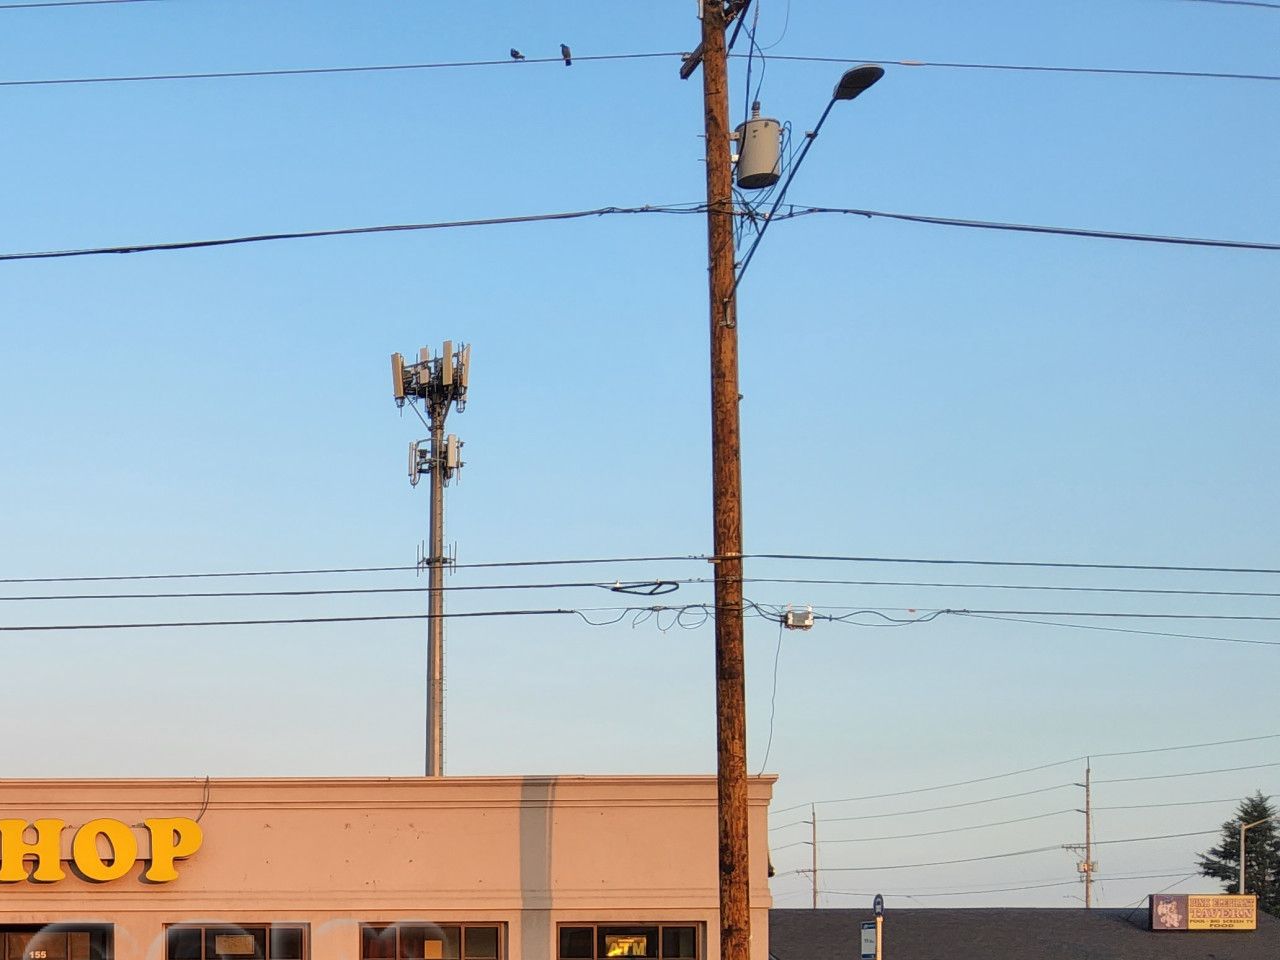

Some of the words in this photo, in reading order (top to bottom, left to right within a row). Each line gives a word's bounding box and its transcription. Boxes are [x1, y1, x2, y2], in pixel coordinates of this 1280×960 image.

[1189, 908, 1253, 919] TAVERN
[29, 950, 47, 959] 155
[608, 943, 645, 955] ATM
